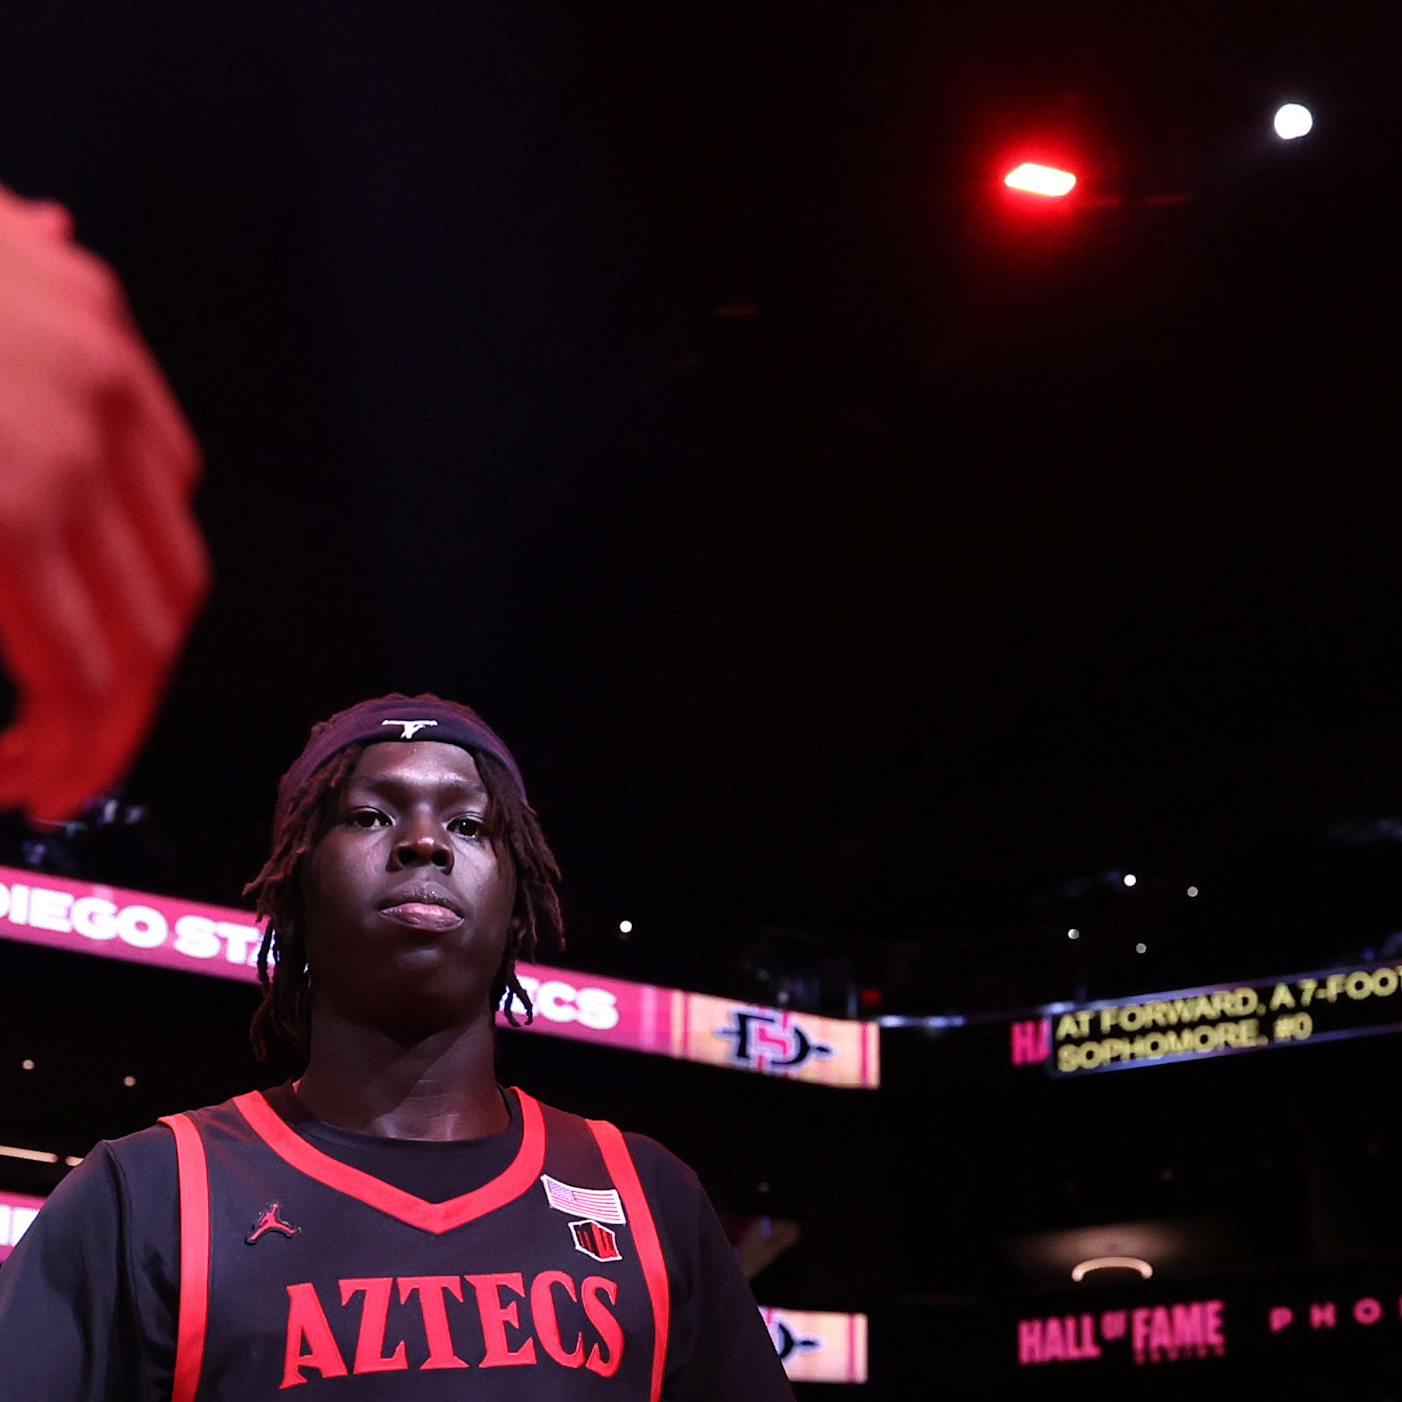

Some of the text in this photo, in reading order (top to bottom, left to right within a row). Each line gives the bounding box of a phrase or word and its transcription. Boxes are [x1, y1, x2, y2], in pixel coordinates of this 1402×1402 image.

[1056, 1011, 1095, 1040] AT
[1270, 983, 1295, 1011] A
[1273, 1012, 1313, 1043] #0
[279, 1270, 625, 1389] AZTECS
[1016, 1312, 1102, 1367] HALL
[1129, 1299, 1226, 1354] FAME
